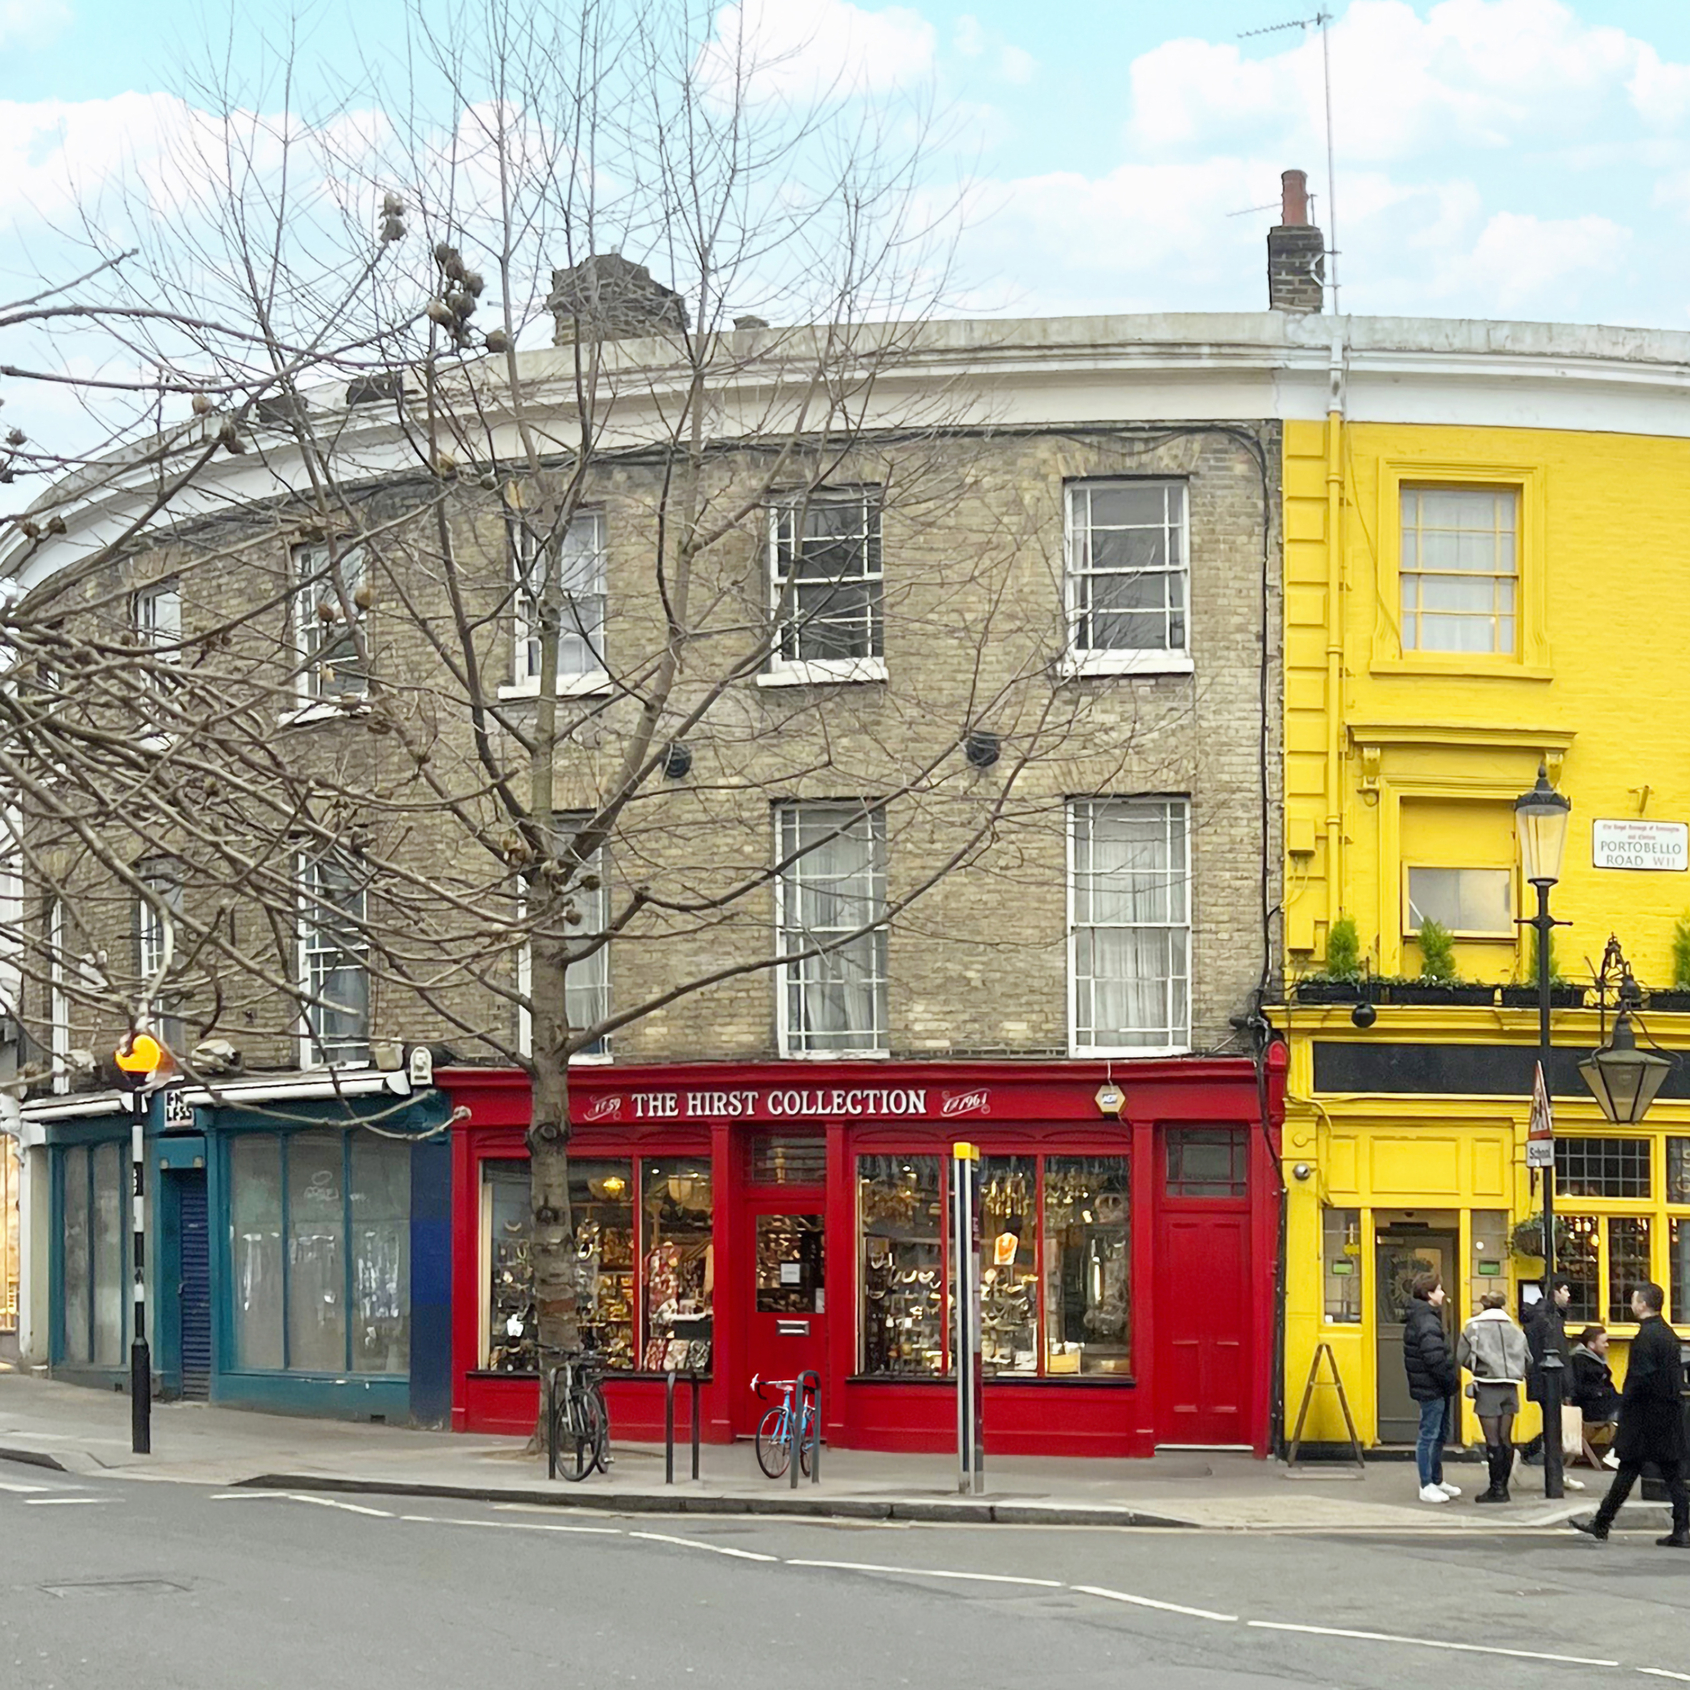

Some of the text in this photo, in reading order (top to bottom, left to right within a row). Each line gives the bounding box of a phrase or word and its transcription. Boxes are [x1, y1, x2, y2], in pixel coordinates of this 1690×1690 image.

[1601, 841, 1682, 855] PORTOBELLO
[1606, 854, 1644, 867] ROAD
[631, 1093, 679, 1117] THE
[686, 1091, 759, 1117] HIRST
[767, 1089, 927, 1116] COLLECTION
[1529, 1146, 1551, 1159] School
